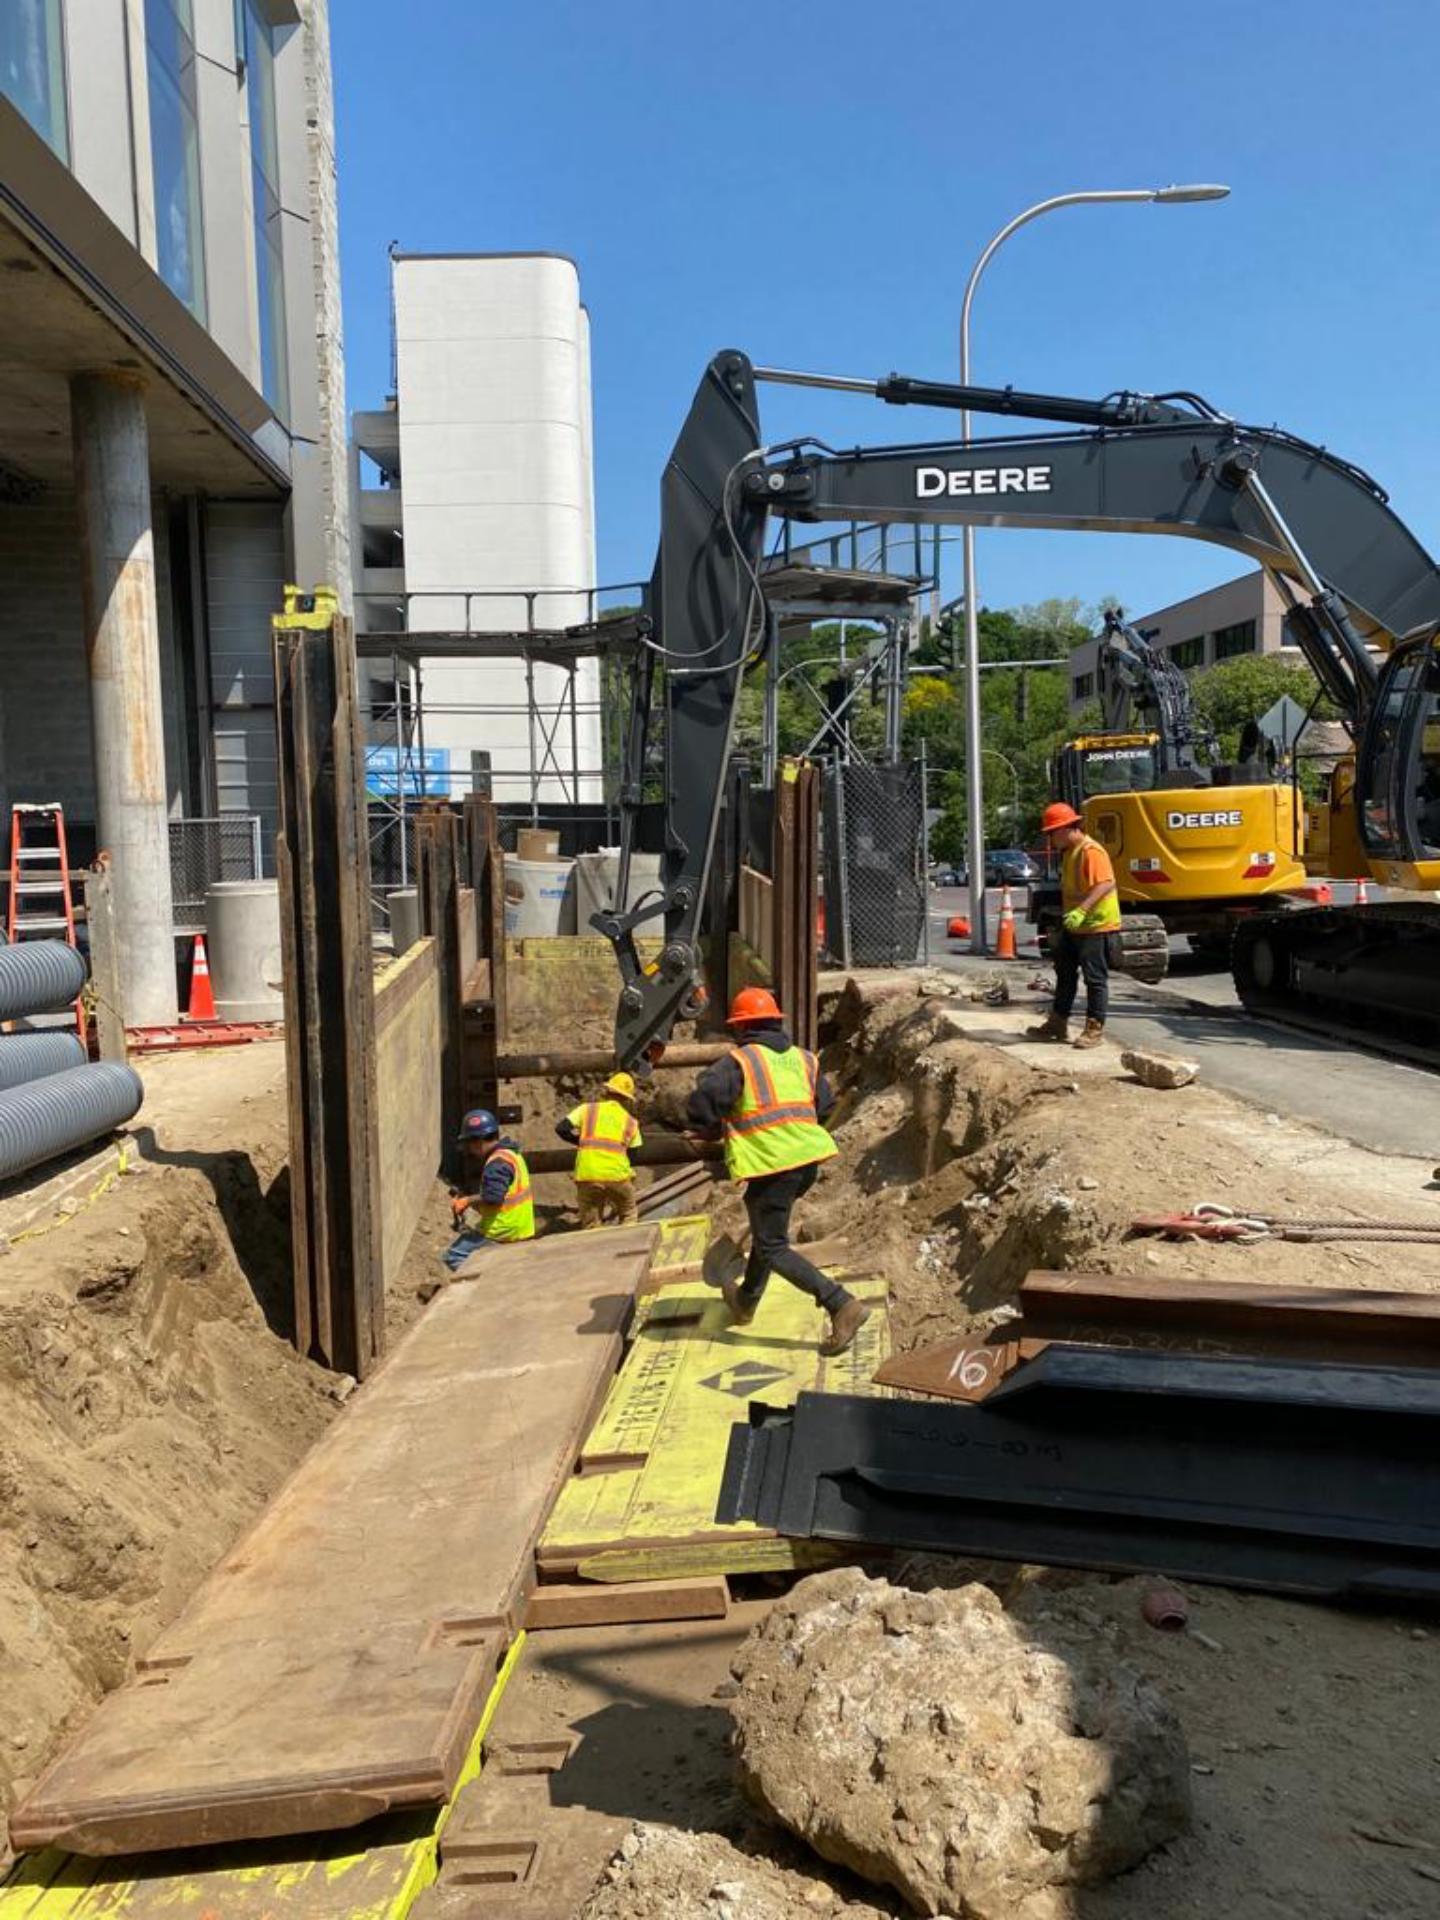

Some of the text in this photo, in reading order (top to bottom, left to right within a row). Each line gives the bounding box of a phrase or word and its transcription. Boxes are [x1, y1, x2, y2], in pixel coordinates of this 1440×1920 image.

[916, 466, 1051, 498] DEERE
[1086, 750, 1151, 762] JOHN DEERE
[1168, 811, 1242, 829] DEERE
